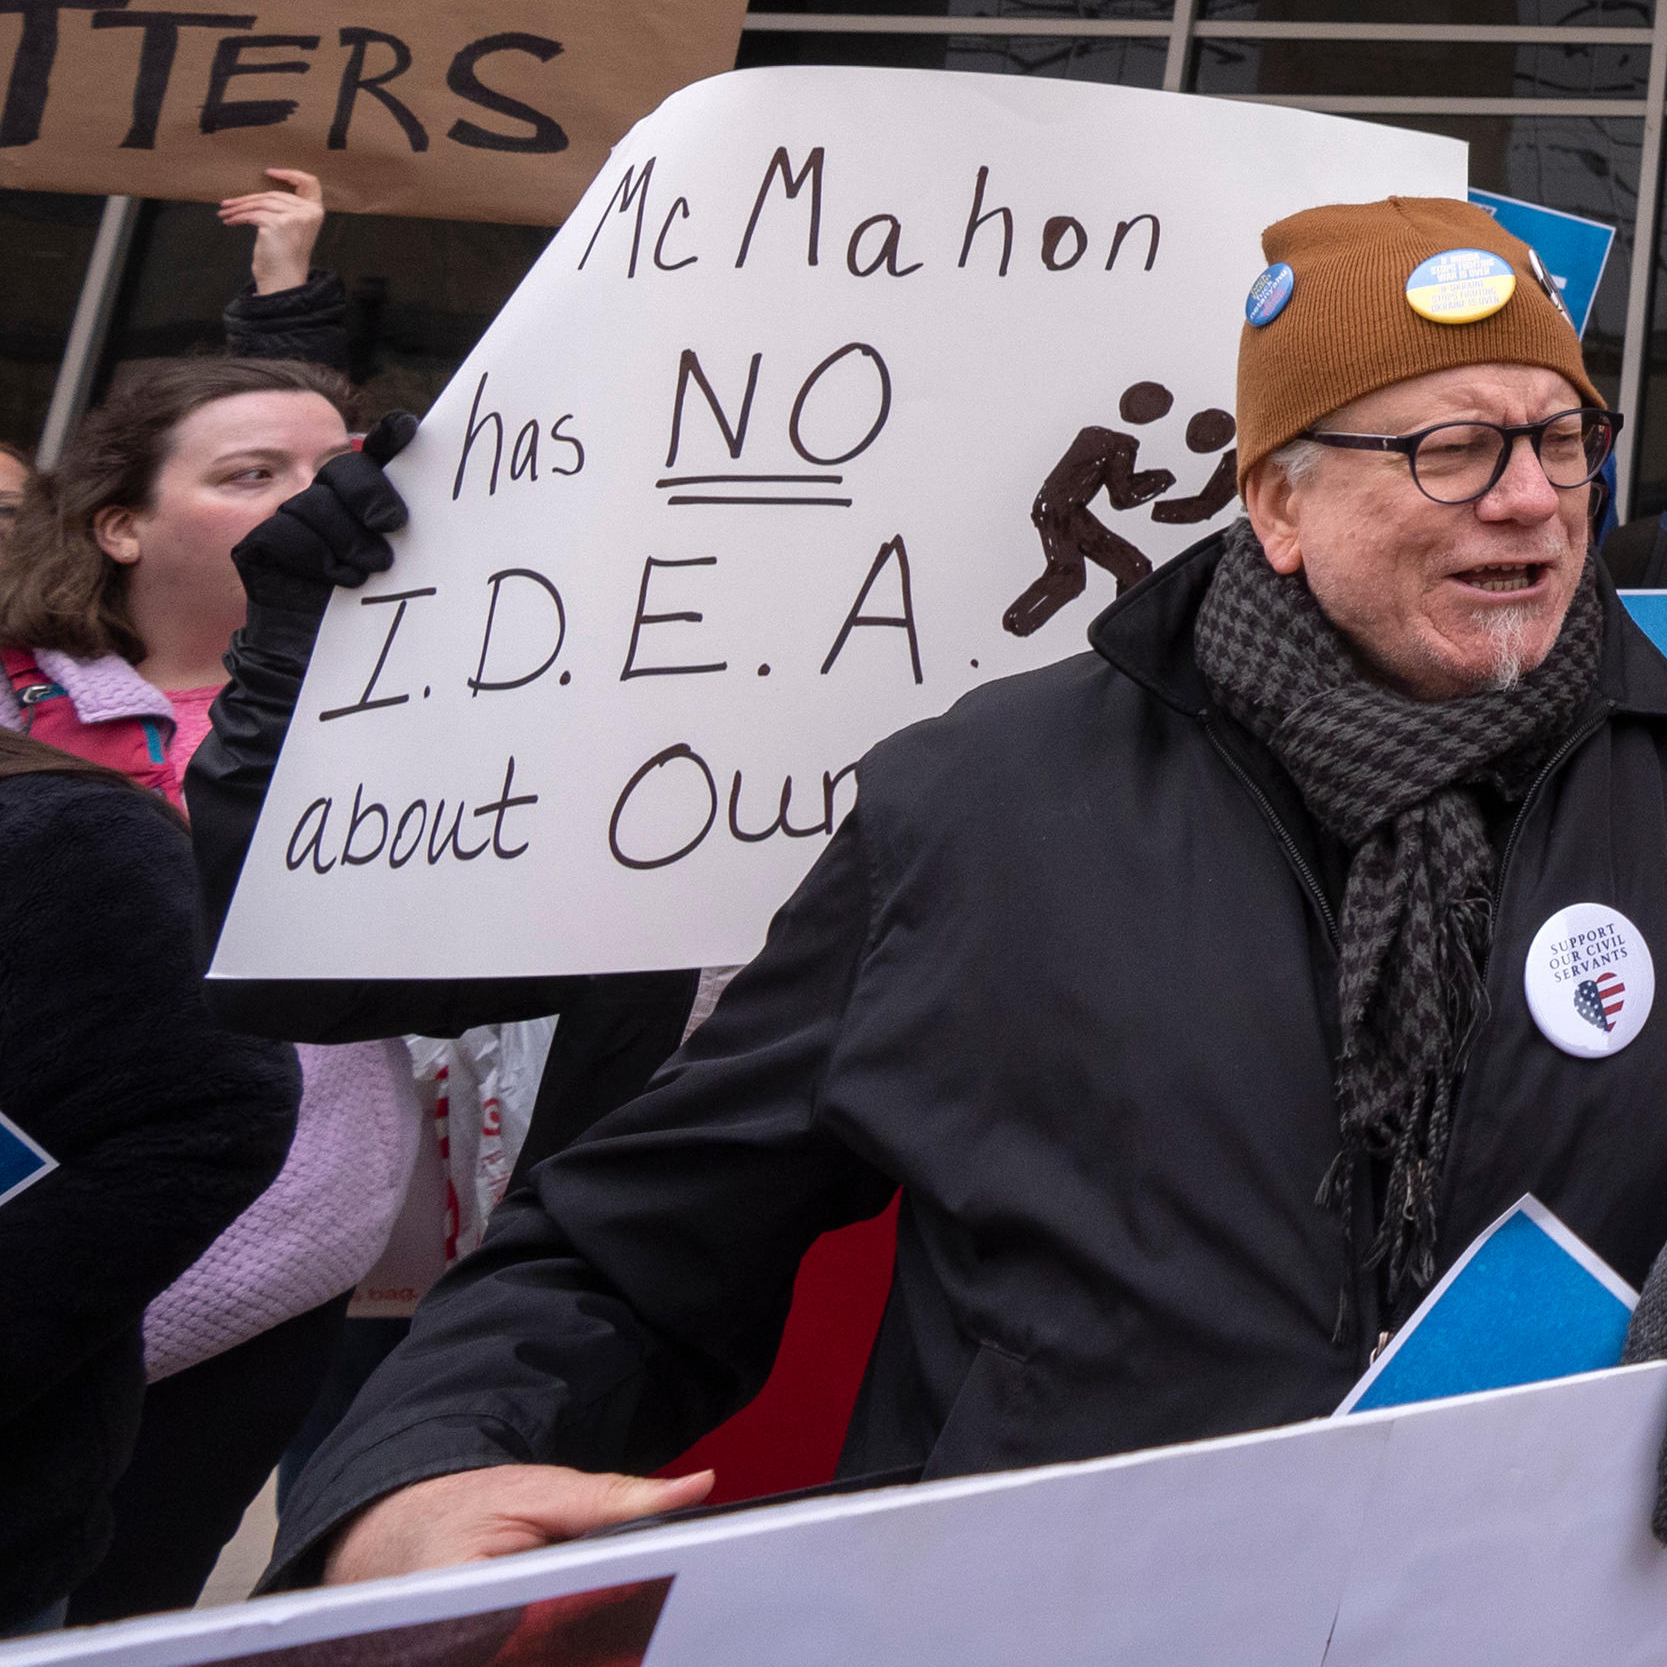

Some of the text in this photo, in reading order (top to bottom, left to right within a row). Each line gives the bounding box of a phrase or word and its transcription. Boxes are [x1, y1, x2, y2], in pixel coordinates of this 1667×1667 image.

[452, 340, 894, 500] has NO
[284, 741, 859, 875] about Our
[1549, 934, 1625, 969] OUR CIVIL
[1550, 923, 1615, 955] SUPPORT
[1554, 947, 1628, 982] SERVANTS
